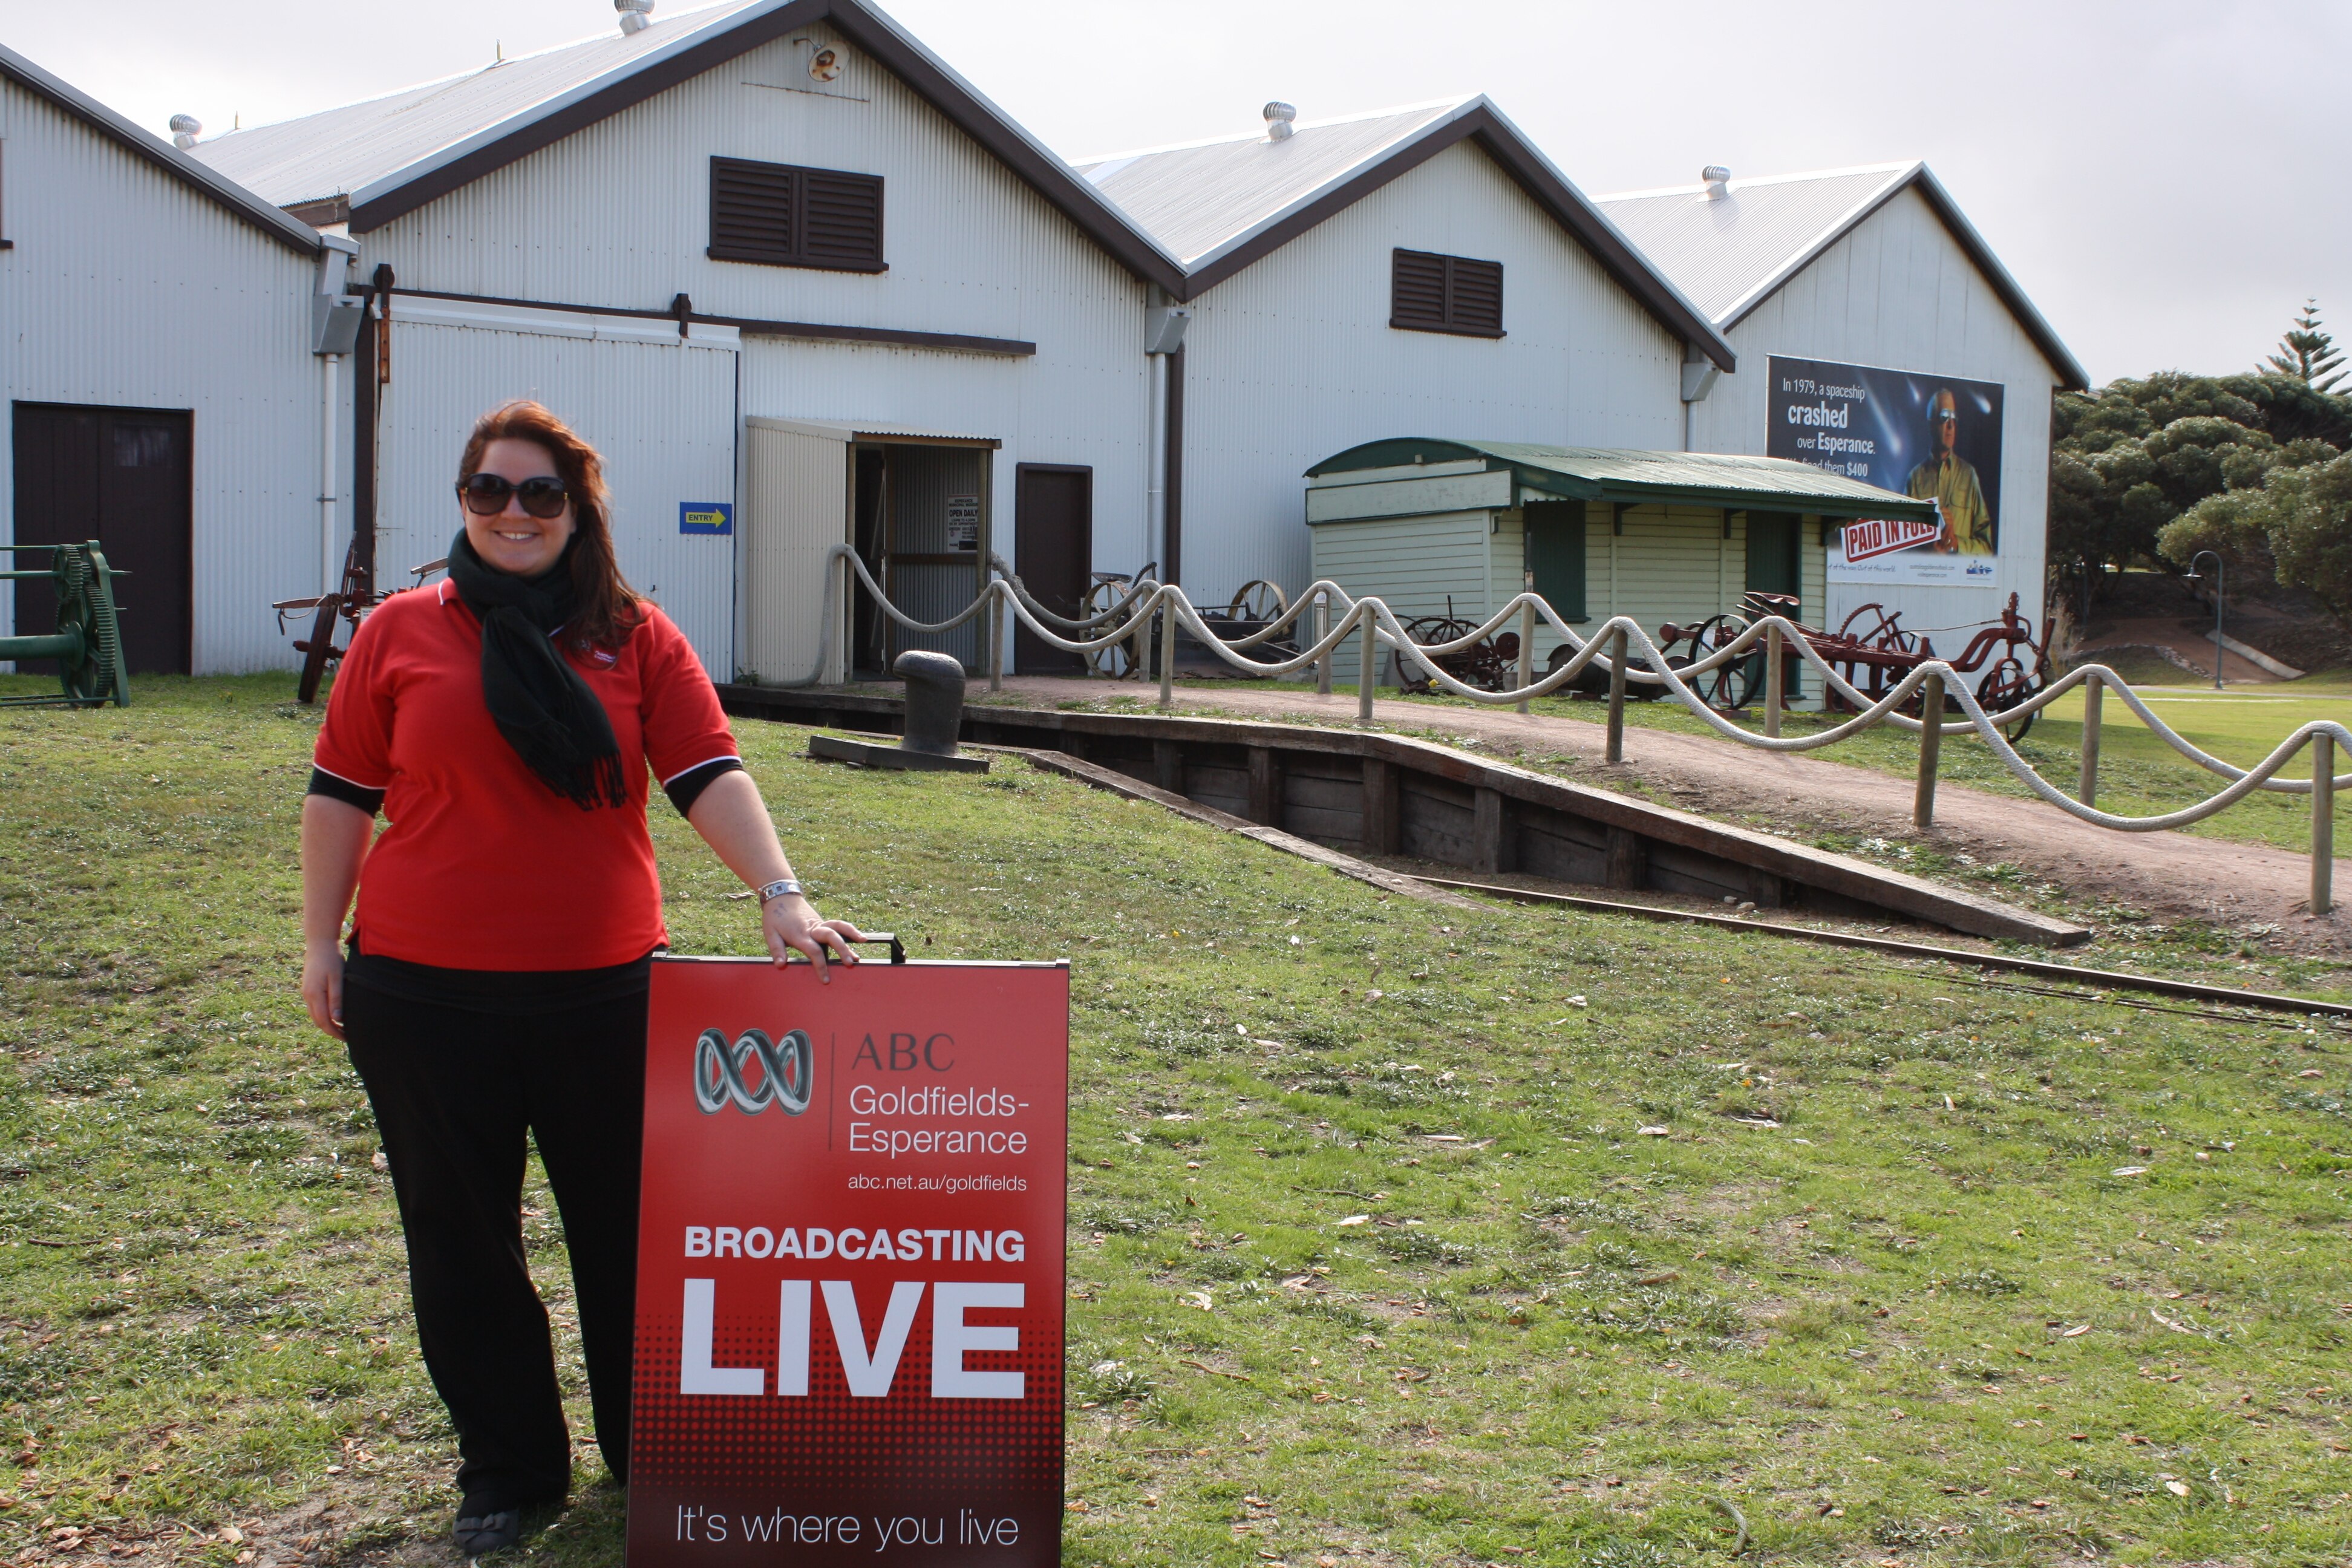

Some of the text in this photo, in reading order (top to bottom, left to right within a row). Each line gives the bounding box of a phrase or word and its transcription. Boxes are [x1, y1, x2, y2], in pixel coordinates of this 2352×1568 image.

[1783, 377, 1865, 403] In 1979, a spaceship
[1788, 400, 1848, 429] crashed
[1797, 432, 1875, 457] over Esperance.
[1824, 460, 1844, 475] them
[1846, 461, 1868, 477] $400
[1849, 522, 1882, 555] PAID
[1885, 521, 1900, 544] IN
[851, 1033, 955, 1072] ABC
[850, 1085, 1029, 1117] Goldfields-
[850, 1122, 1027, 1160] Esperance
[848, 1174, 1027, 1194] abc.net.au/goldfields
[684, 1226, 1025, 1263] BROADCASTING
[680, 1278, 1025, 1400] LIVE
[677, 1505, 1019, 1552] It's where you live
